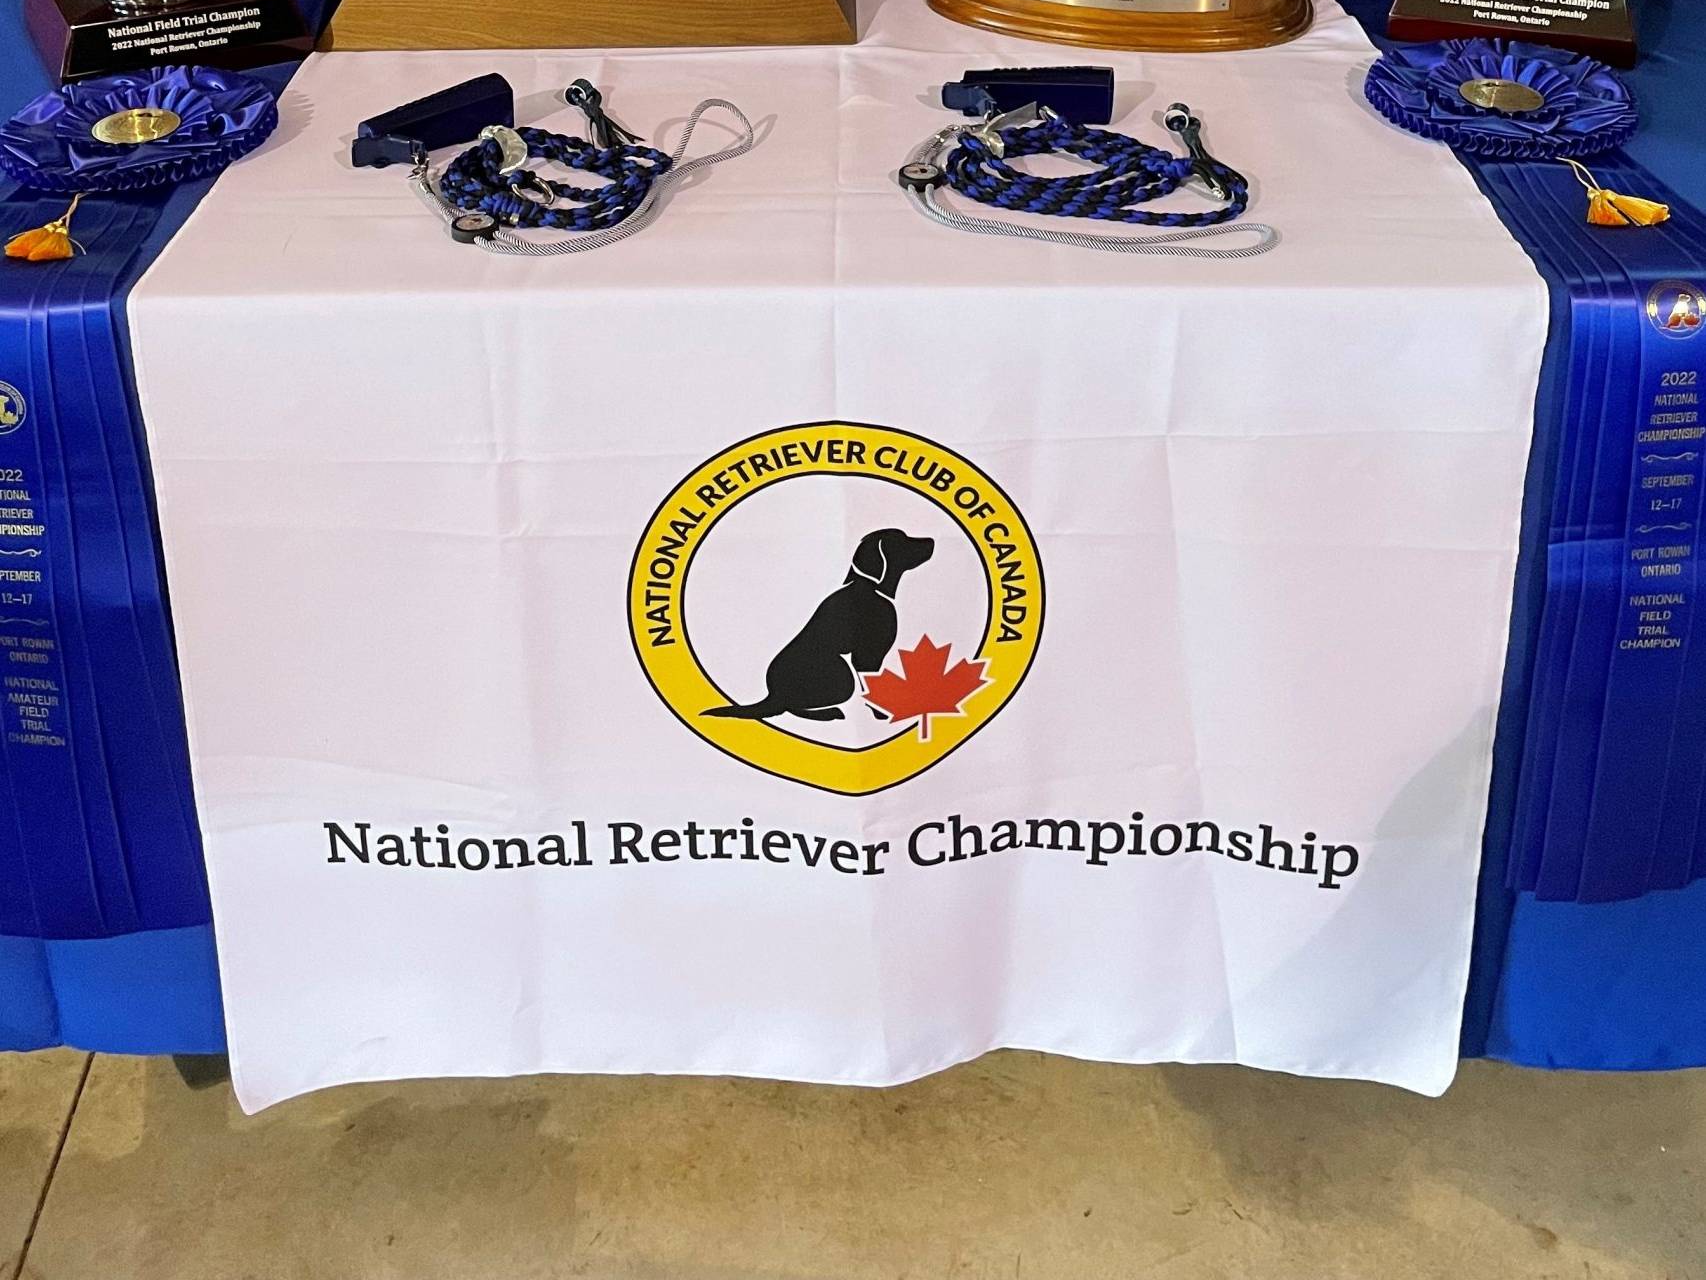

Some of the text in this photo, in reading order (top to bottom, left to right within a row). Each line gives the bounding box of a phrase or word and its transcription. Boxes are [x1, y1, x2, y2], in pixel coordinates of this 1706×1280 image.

[1473, 10, 1550, 26] Port Rowan, Ontario
[1494, 1, 1530, 13] Retriever
[1531, 5, 1587, 20] Championship
[107, 7, 261, 39] National Field Trial Champion
[111, 20, 262, 51] 2022 National Retriever Championship
[150, 36, 229, 56] Port Rowan, Ontario
[1661, 371, 1697, 386] 2022
[1654, 393, 1698, 406] NATIONAL
[1650, 412, 1698, 425] RETRIEVER
[1638, 427, 1706, 442] CHAMPIONSHIP
[1641, 474, 1695, 489] SEPTEMBER
[645, 439, 1028, 647] NATIONAL RETRIEVER CLUB OF CANADA
[1631, 544, 1691, 560] PORT ROWAN
[1641, 563, 1681, 578] ONTARIO
[1629, 593, 1685, 607] NATIONAL
[1639, 610, 1671, 622] FIELD
[1638, 625, 1669, 636] TRIAL
[0, 636, 55, 650] ORT ROWAN
[1620, 638, 1681, 650] CHAMPION
[9, 651, 49, 665] ONTARIO
[4, 676, 59, 692] NATIONAL
[8, 692, 59, 706] AMATEUR
[19, 705, 49, 718] FIELD
[21, 719, 52, 732] TRIAL
[8, 732, 66, 747] CHAMPION
[324, 812, 1358, 889] National Retriever Championship
